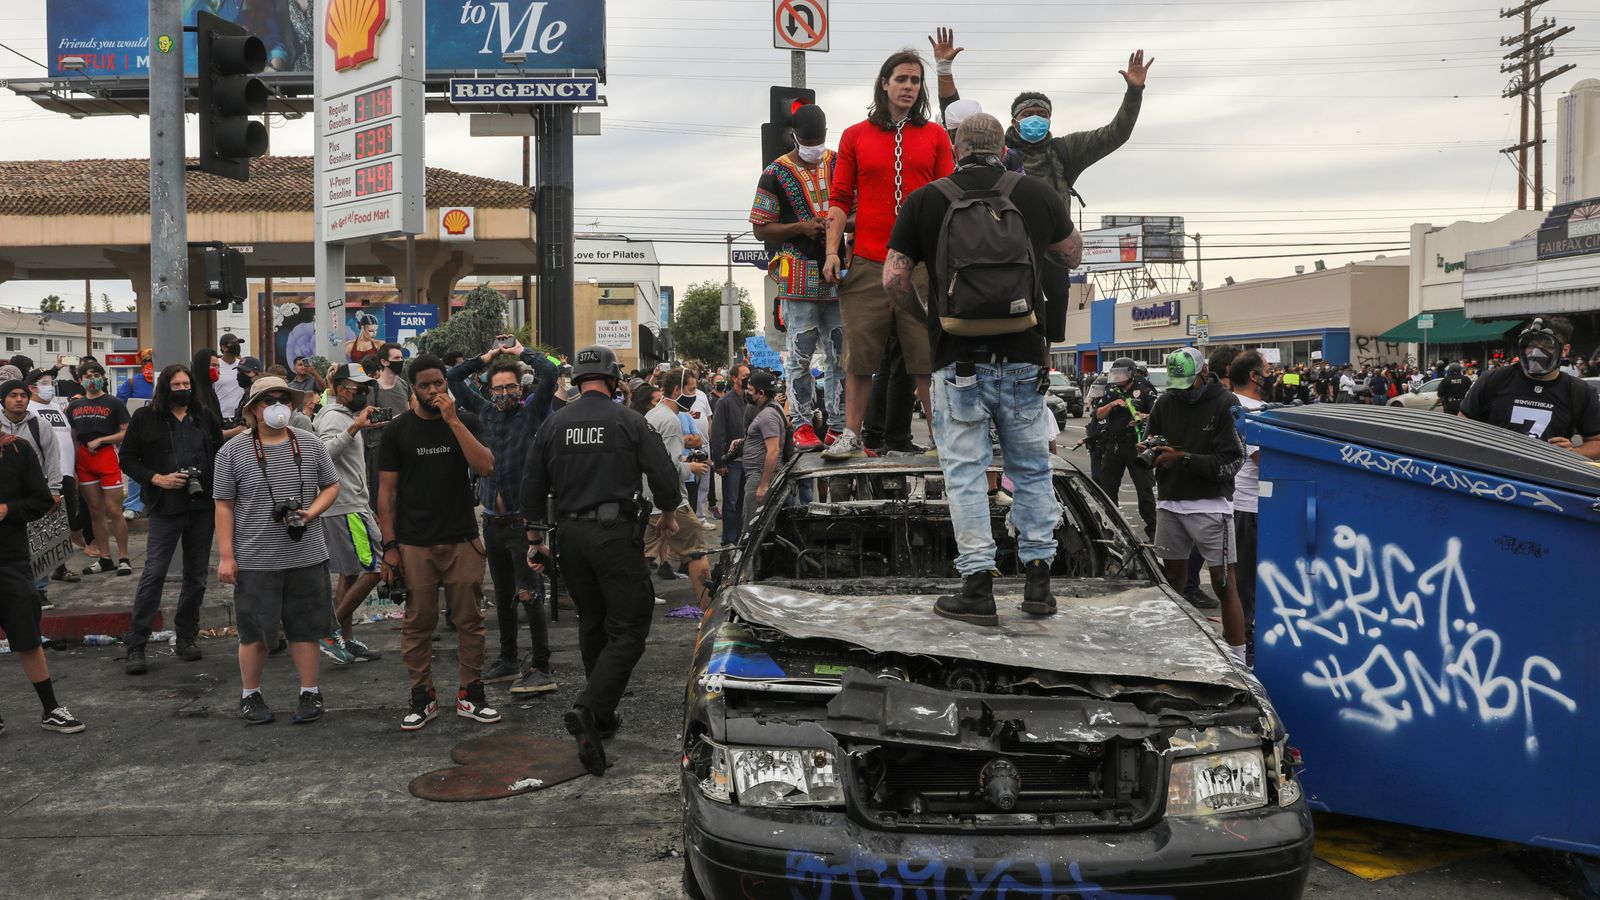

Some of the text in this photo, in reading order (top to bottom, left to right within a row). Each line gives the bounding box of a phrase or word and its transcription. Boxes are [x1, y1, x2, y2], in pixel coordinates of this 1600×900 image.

[460, 0, 486, 24] to
[478, 1, 567, 54] Me
[59, 37, 148, 51] Friends you would
[455, 83, 592, 97] REGENCY
[329, 102, 349, 117] Regular
[329, 116, 352, 130] Gasoline
[329, 141, 340, 153] Plus
[329, 152, 352, 165] Gasoline
[329, 176, 351, 188] V-Power
[329, 188, 352, 201] Gasoline
[354, 211, 372, 224] Food
[373, 209, 390, 220] Mart
[1540, 238, 1582, 255] FAIRFAX
[574, 250, 645, 259] ove for Pilates
[733, 251, 769, 261] FAIRFAX
[1132, 301, 1171, 322] Goodwill
[400, 317, 426, 326] EARN
[72, 405, 112, 417] WARNING
[1510, 405, 1553, 438] 7
[566, 427, 605, 445] POLICE
[416, 445, 451, 456] Westside
